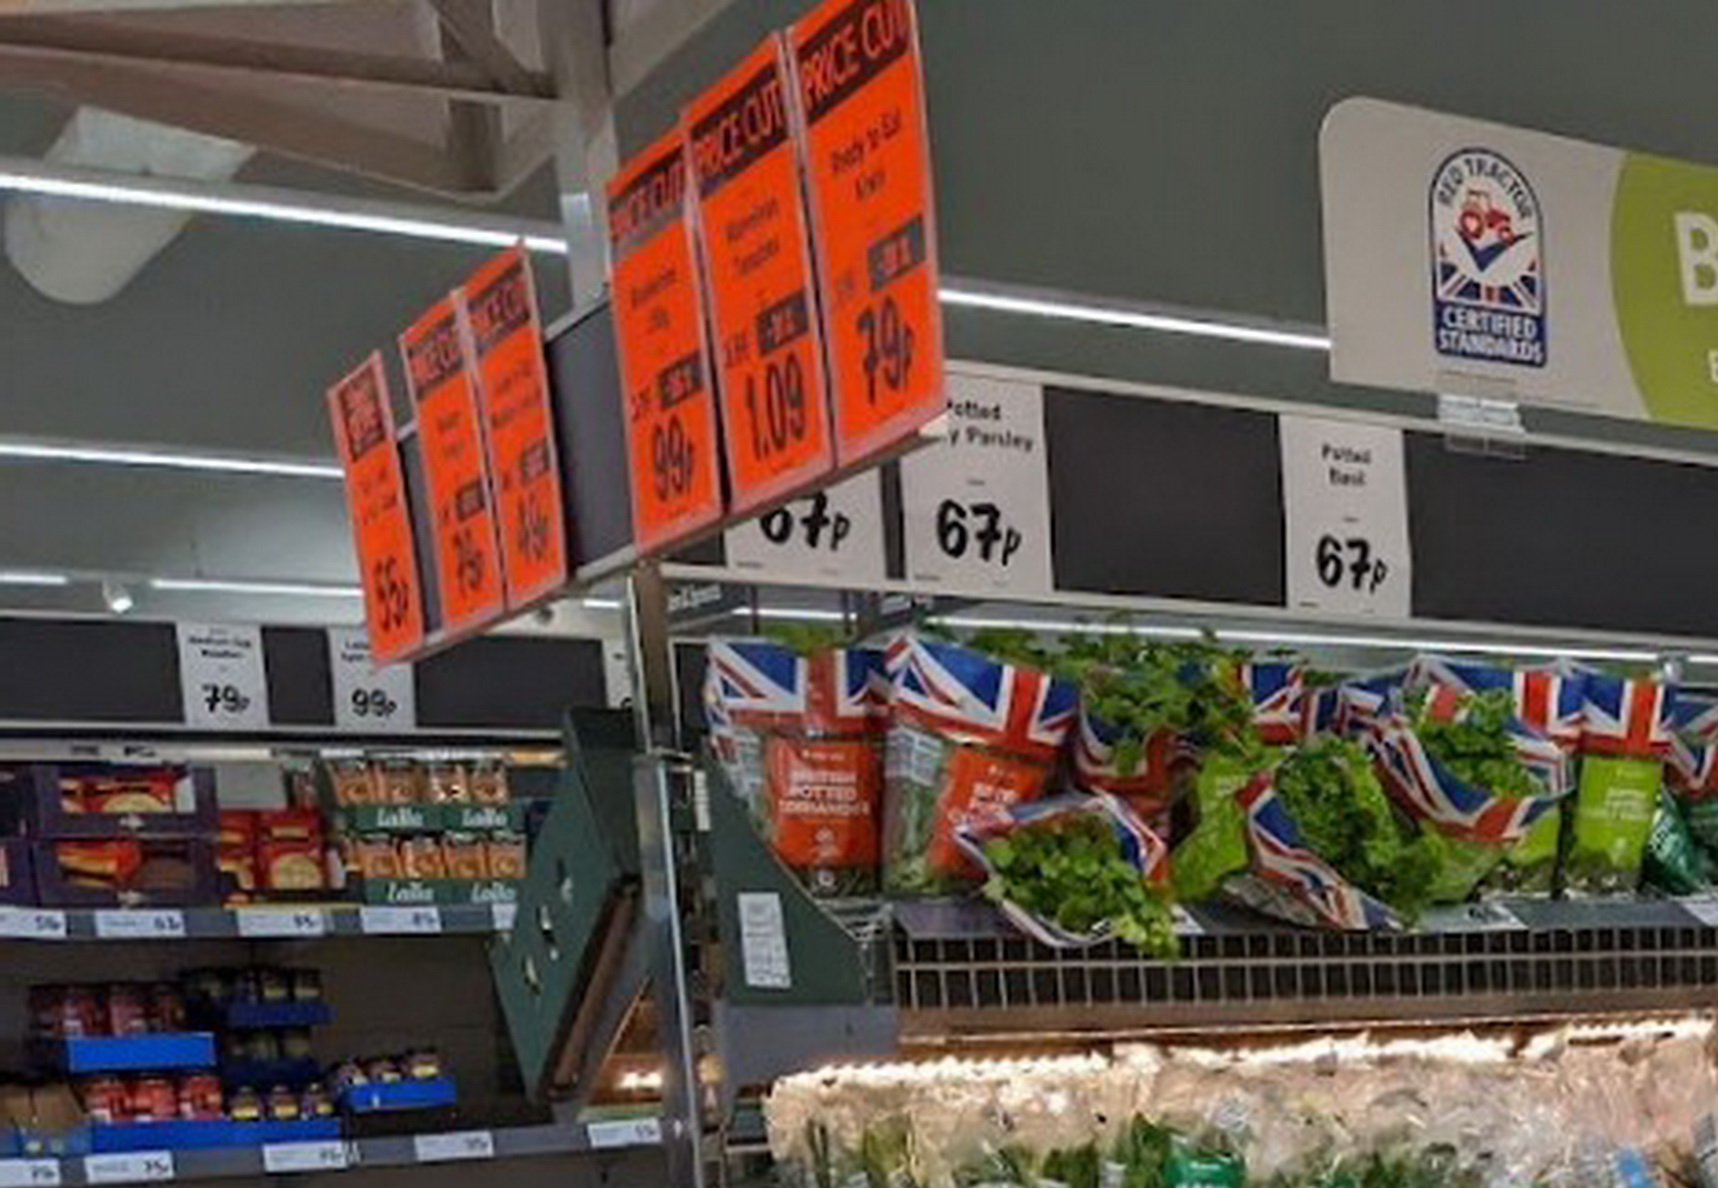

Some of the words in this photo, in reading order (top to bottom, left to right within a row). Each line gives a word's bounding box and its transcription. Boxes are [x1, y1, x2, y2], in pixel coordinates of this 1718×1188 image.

[1437, 167, 1464, 207] RED
[1464, 157, 1533, 220] TRACTOR
[1439, 327, 1543, 364] STANDARDS
[1443, 307, 1537, 340] CERTIFIED
[946, 399, 1001, 420] otted
[936, 498, 1021, 567] 67p
[1316, 532, 1389, 596] 67p
